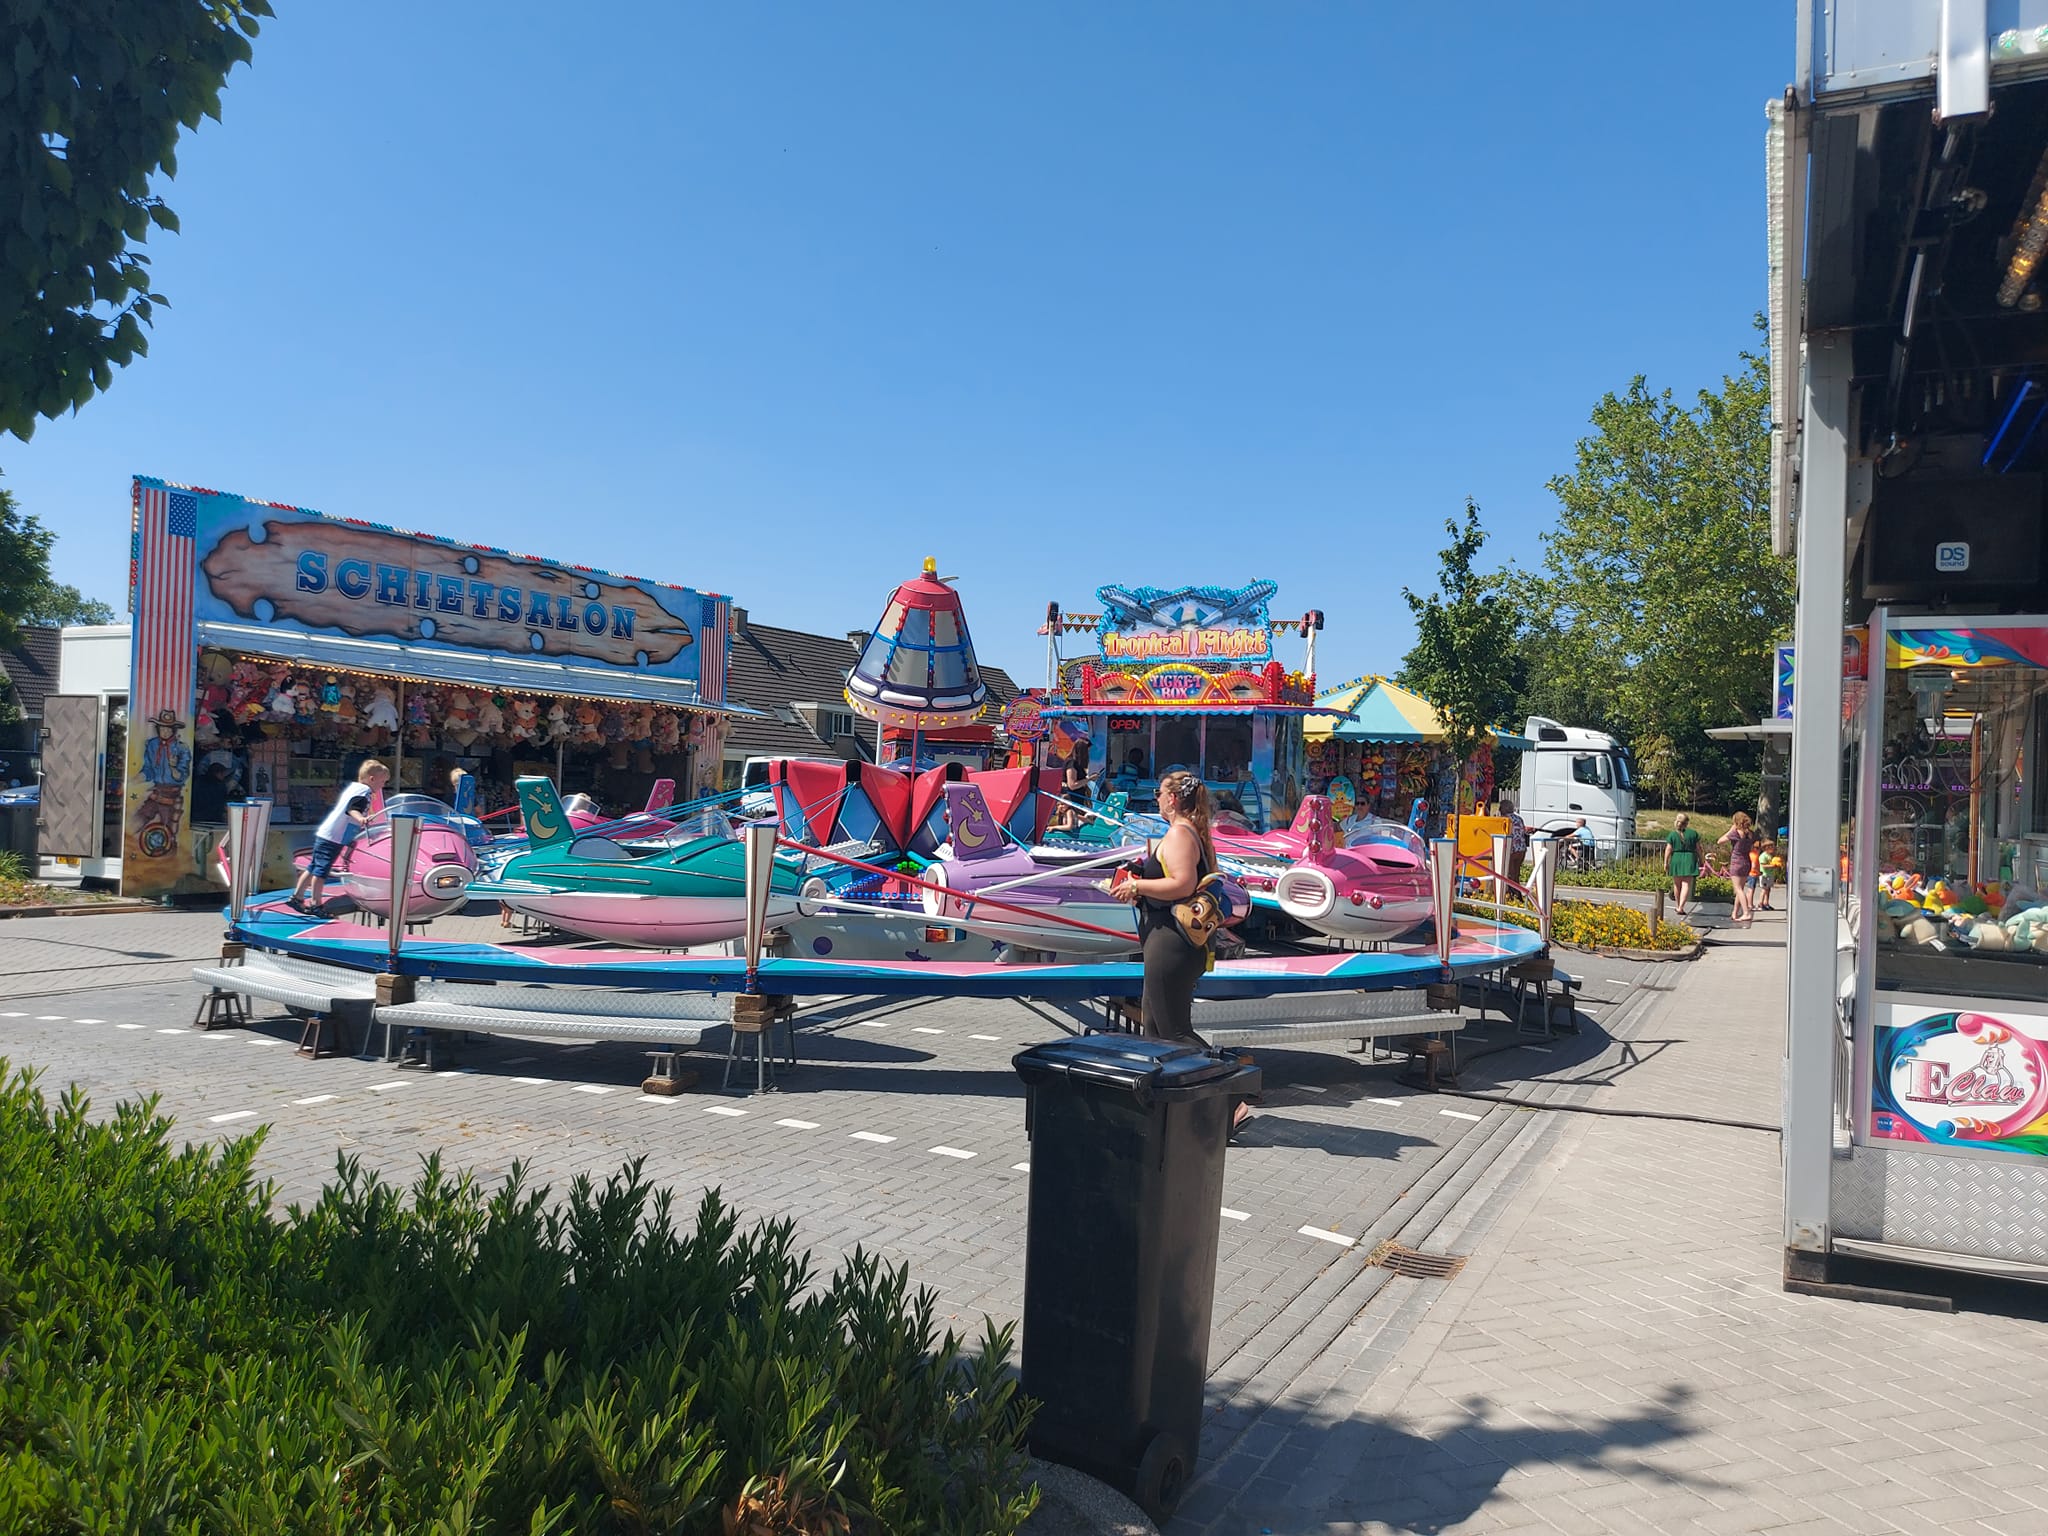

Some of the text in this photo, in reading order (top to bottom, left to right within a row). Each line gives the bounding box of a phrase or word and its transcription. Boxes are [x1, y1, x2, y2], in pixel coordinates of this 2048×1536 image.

[1941, 547, 1965, 560] DS
[296, 551, 635, 640] SCHIETSALON
[1104, 629, 1268, 659] Tropical Flight
[1149, 674, 1202, 688] TICKET
[1161, 687, 1188, 699] BOX
[1110, 719, 1141, 730] OPEN
